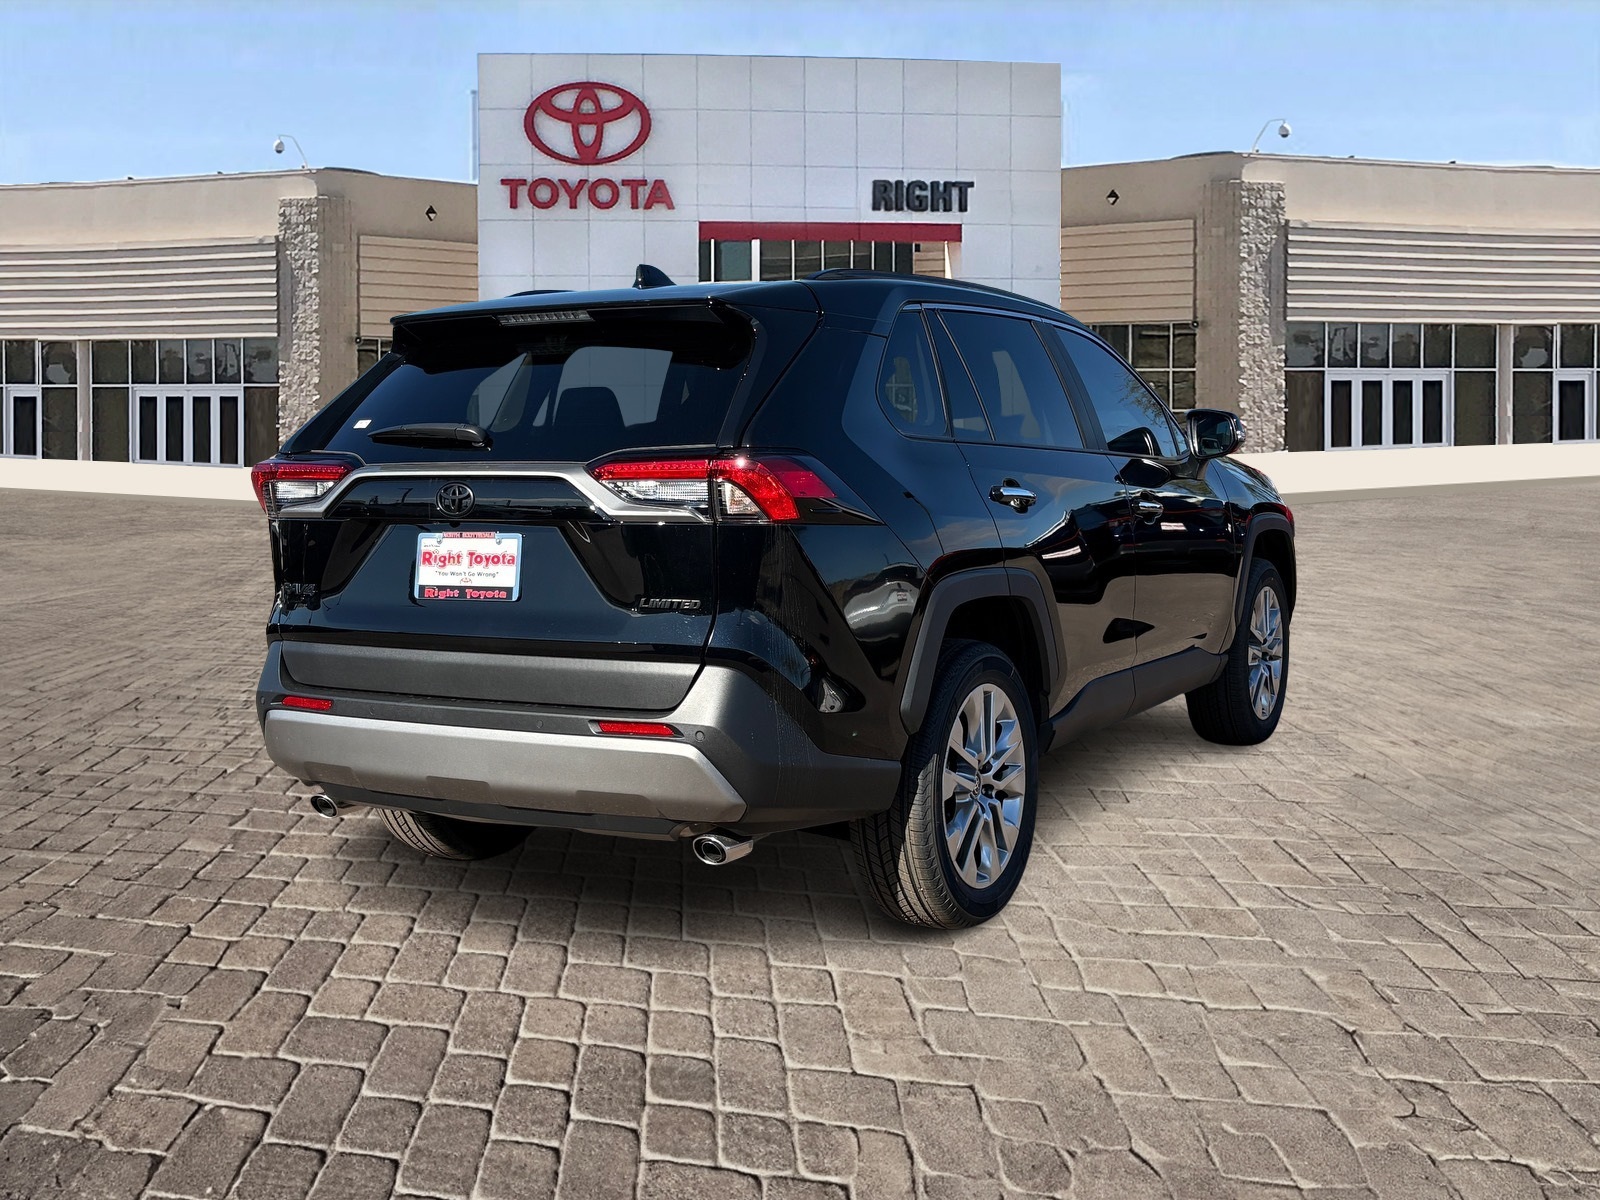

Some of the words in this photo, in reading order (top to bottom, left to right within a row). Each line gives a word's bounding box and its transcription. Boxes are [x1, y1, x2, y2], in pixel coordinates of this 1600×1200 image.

[499, 178, 675, 210] TOYOTA
[870, 179, 976, 213] RIGHT
[422, 551, 462, 568] Right
[467, 550, 516, 568] Toyota
[424, 587, 460, 599] Right
[465, 588, 507, 599] Toyota
[639, 597, 701, 610] LIMITED
